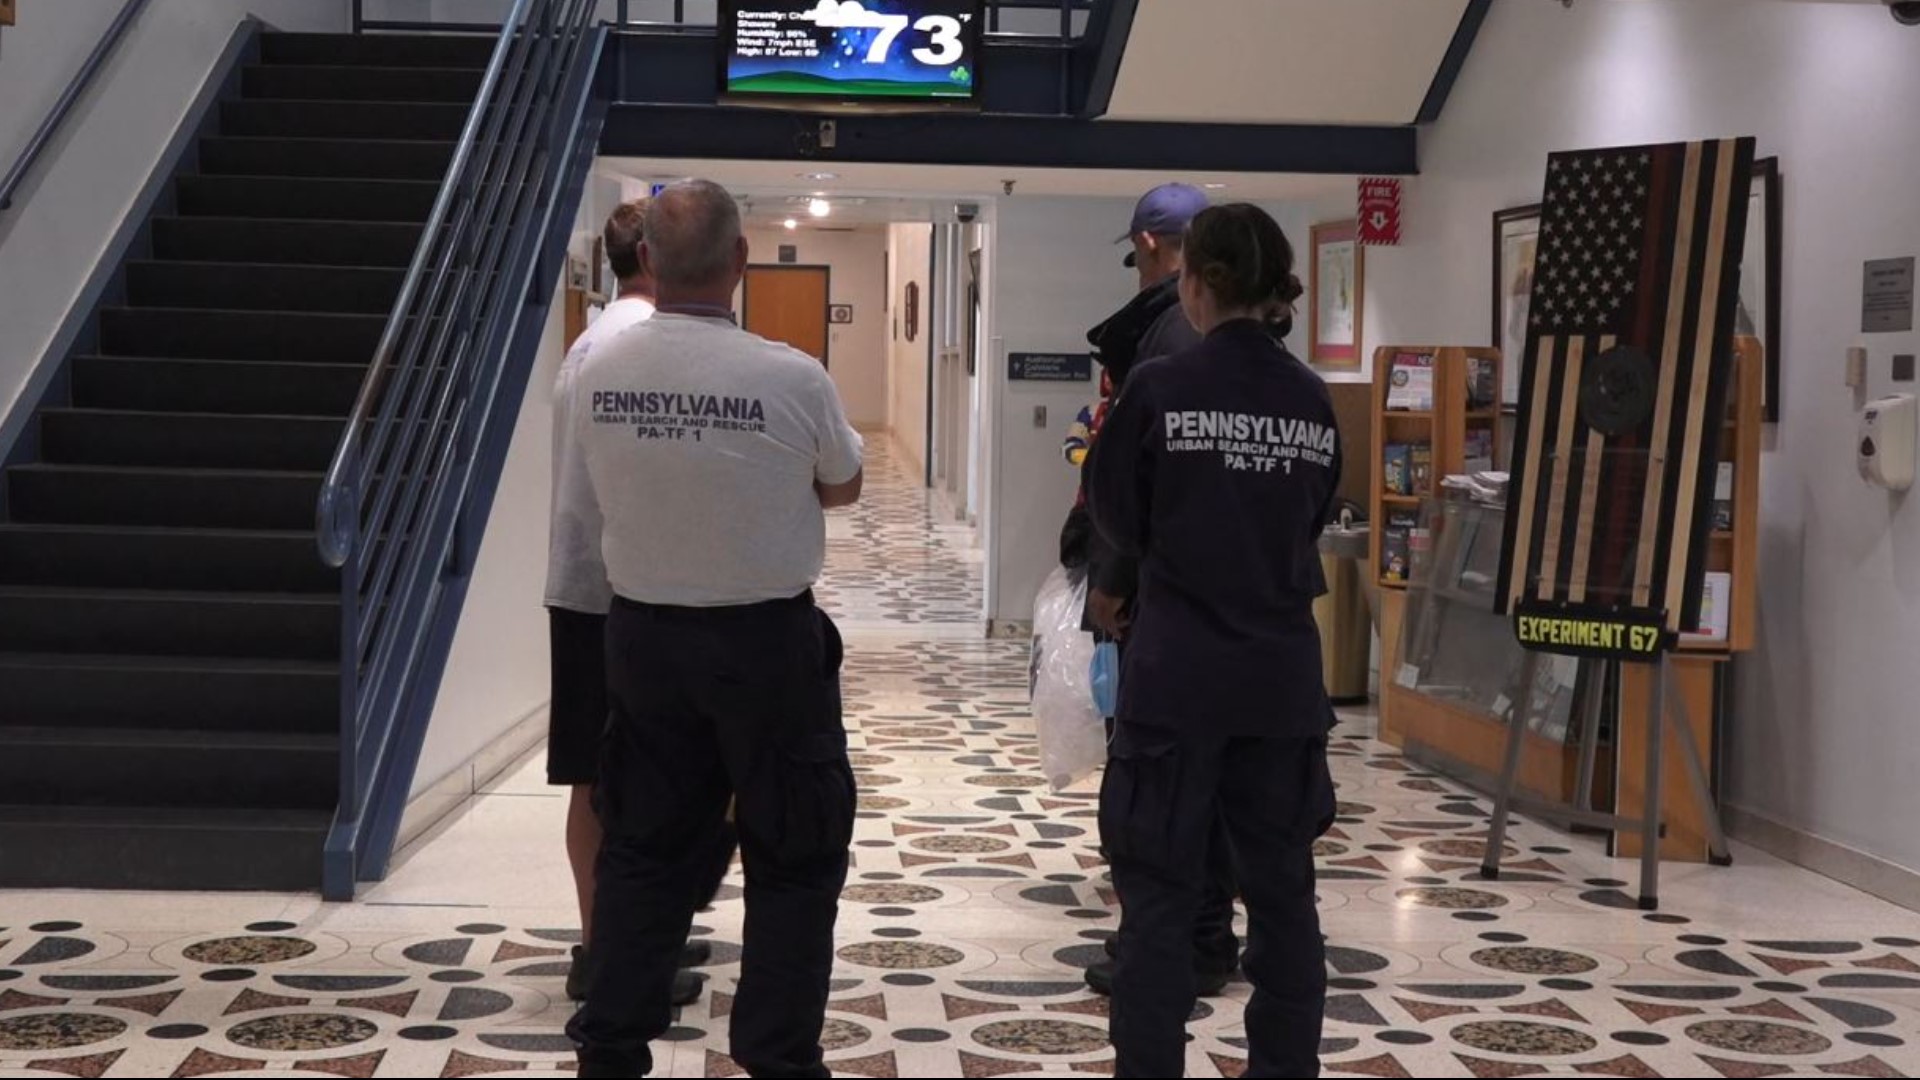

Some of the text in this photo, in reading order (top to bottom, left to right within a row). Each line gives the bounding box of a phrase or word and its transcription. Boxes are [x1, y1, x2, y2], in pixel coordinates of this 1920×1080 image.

[737, 10, 786, 21] Currently:
[737, 20, 777, 28] Showers
[737, 29, 784, 39] Humidity:
[737, 38, 765, 46] Wind:
[863, 14, 963, 65] 73
[737, 47, 763, 57] High:
[778, 48, 802, 57] Low:
[1366, 186, 1393, 198] FIRE
[592, 391, 765, 422] PENNSYLVANIA
[593, 414, 766, 433] URBAN SEARCH AND RESCUE
[637, 426, 702, 442] PA-TF 1
[1166, 439, 1214, 452] URBAN
[1217, 440, 1268, 456] SEARCH
[1271, 446, 1299, 459] AND
[1224, 453, 1292, 475] PA-TF 1
[1518, 616, 1659, 652] EXPERIMENT 67
